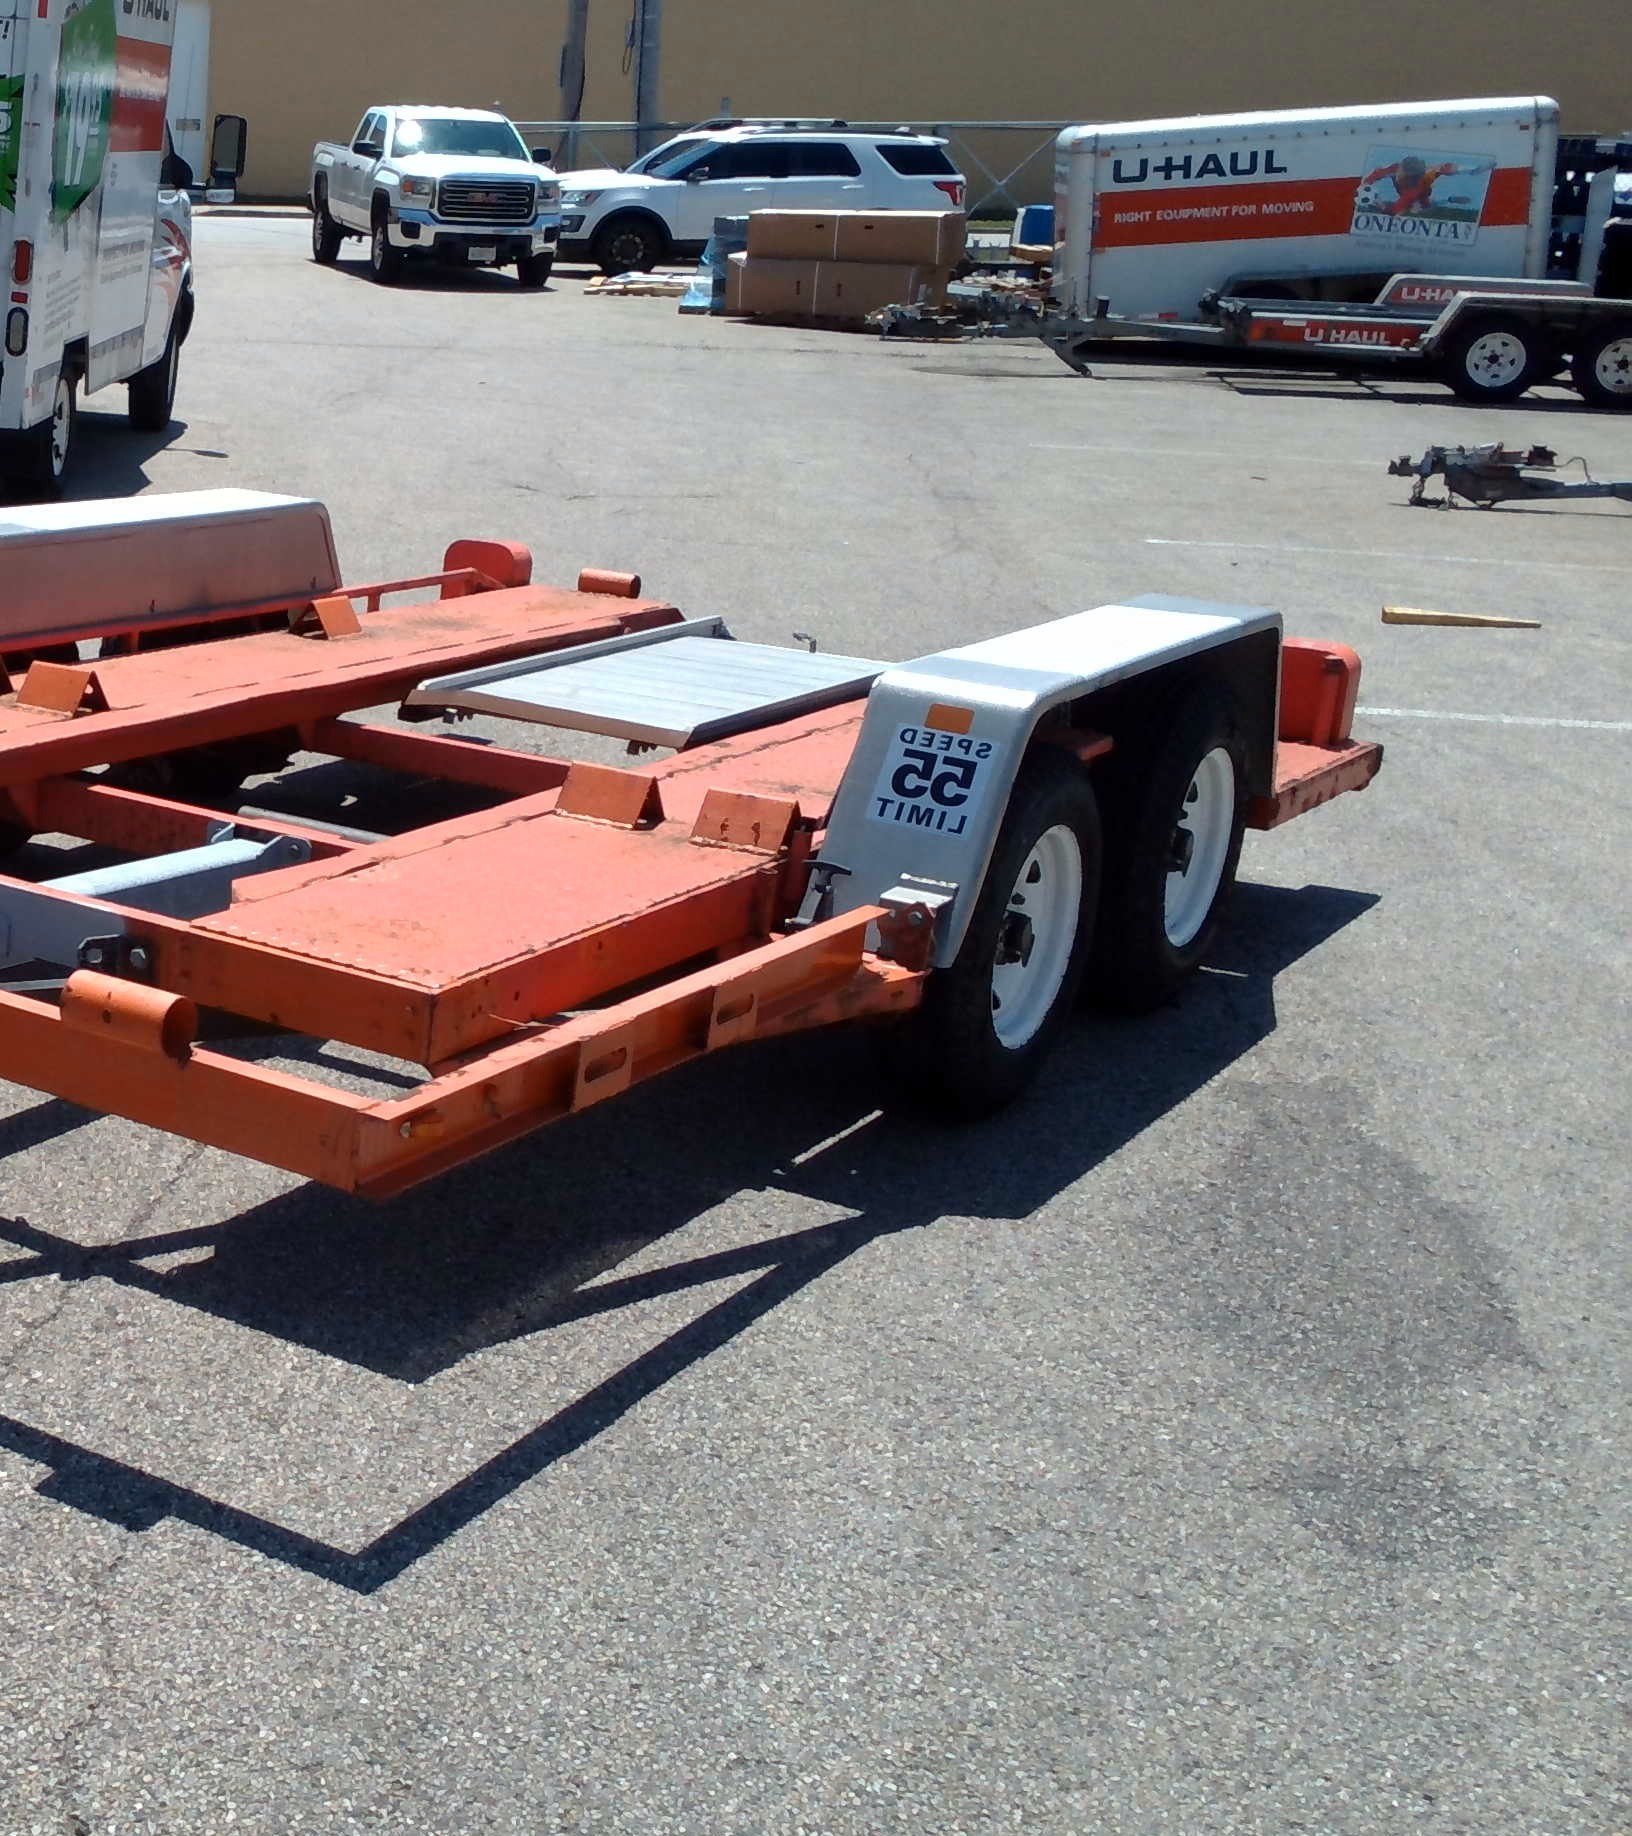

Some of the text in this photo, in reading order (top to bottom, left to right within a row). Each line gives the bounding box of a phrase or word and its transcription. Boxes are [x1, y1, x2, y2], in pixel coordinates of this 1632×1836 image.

[1113, 150, 1287, 184] U-HAUL
[1114, 201, 1314, 224] RIGHT EQUIPMENT FOR MOVING
[1401, 287, 1456, 300] U-HA
[1304, 327, 1392, 344] UHAUL
